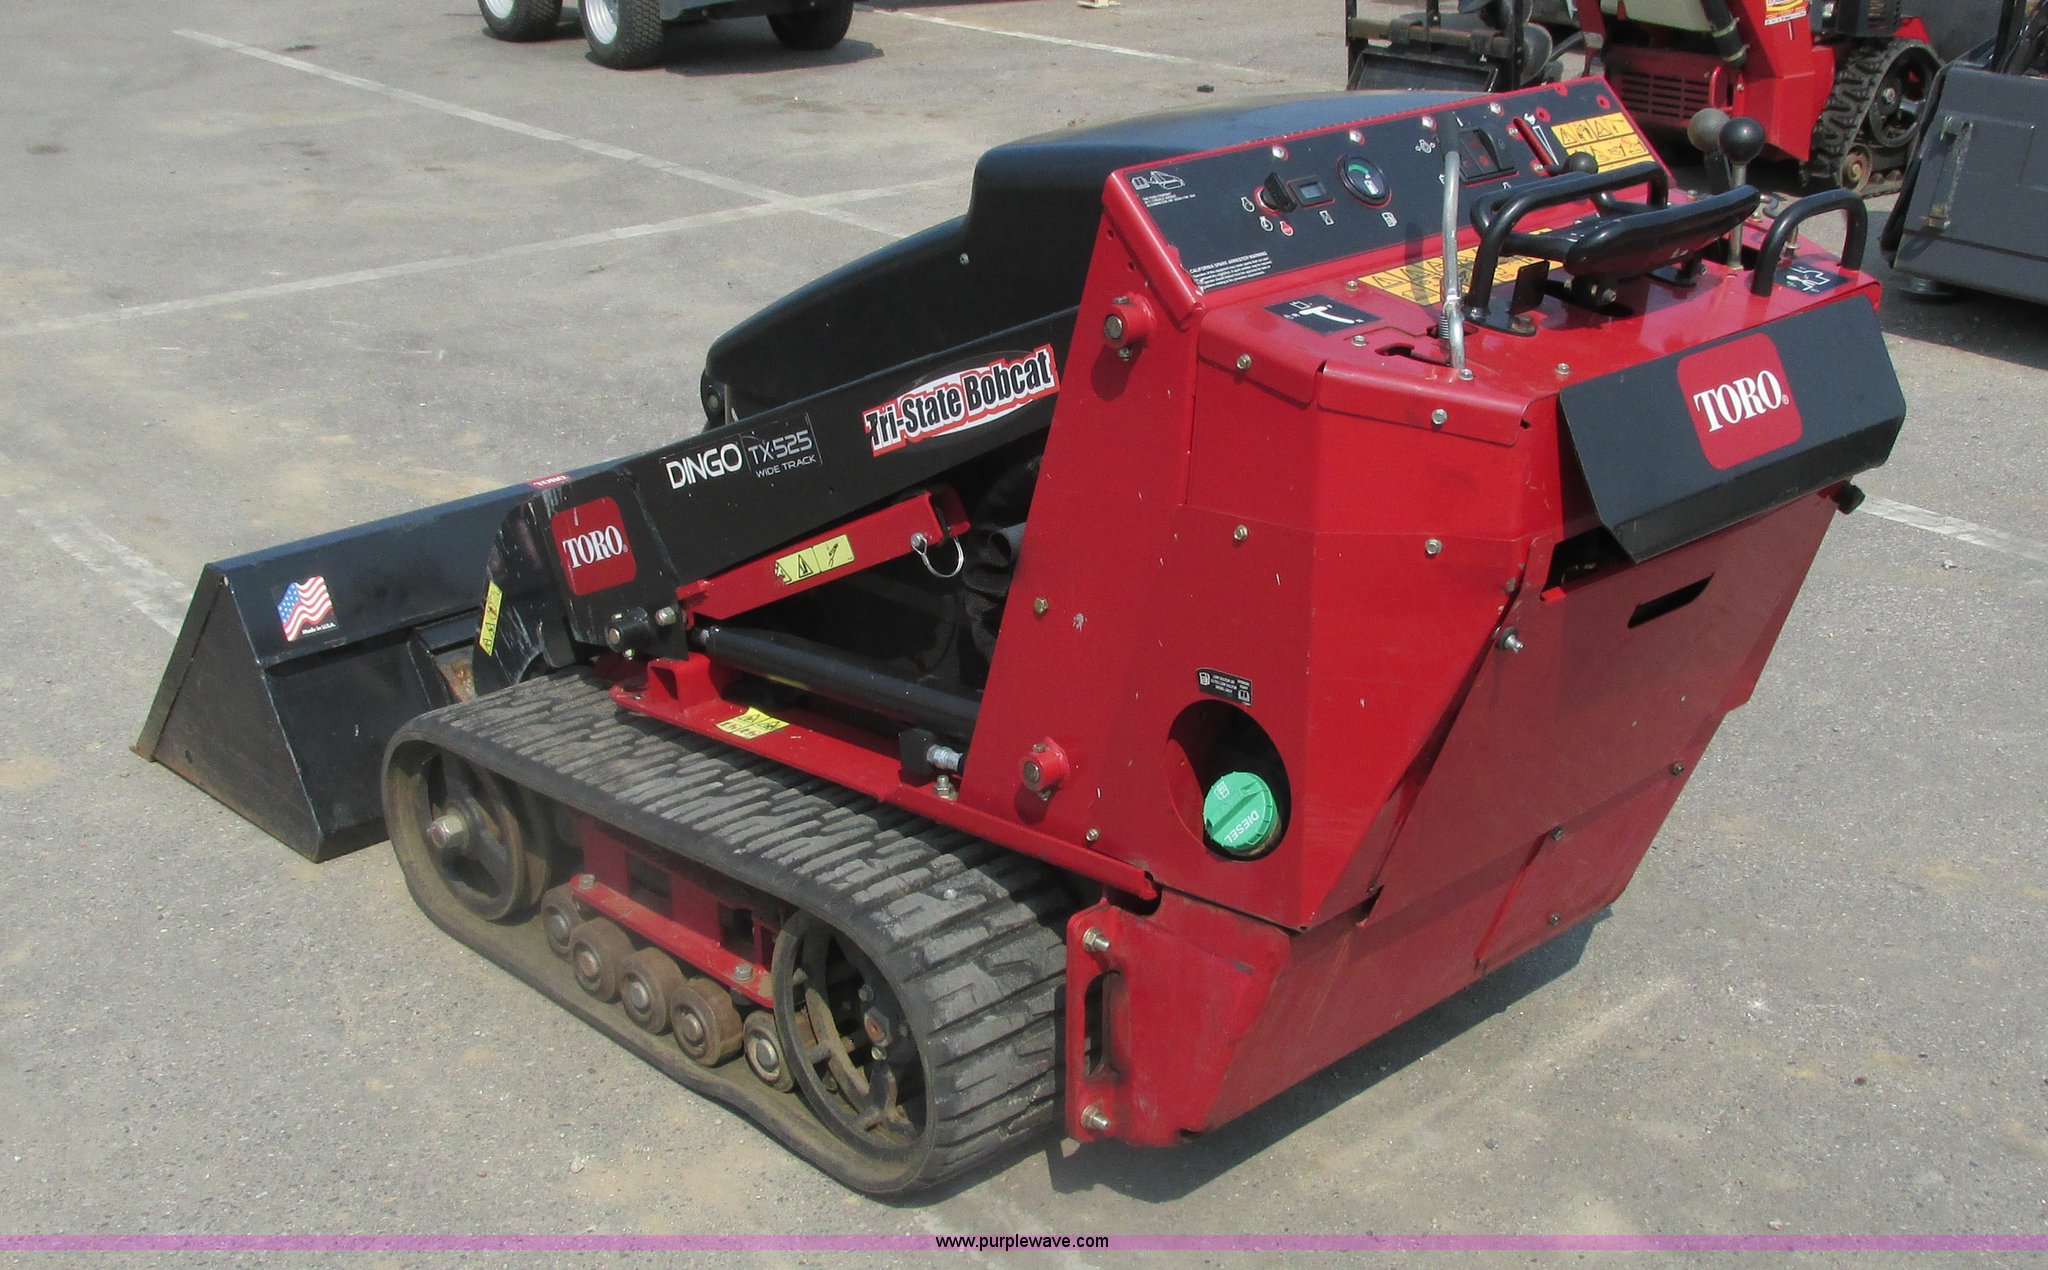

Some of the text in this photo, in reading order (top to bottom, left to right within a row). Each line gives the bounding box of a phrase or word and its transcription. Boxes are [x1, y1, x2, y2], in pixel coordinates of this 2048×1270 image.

[866, 350, 1051, 446] Tri-State Bobcat
[1693, 370, 1782, 432] TORO
[666, 443, 742, 489] DINGO
[755, 454, 817, 478] WIDE TRACK
[562, 525, 623, 568] TORO
[1224, 810, 1260, 843] DIESEL
